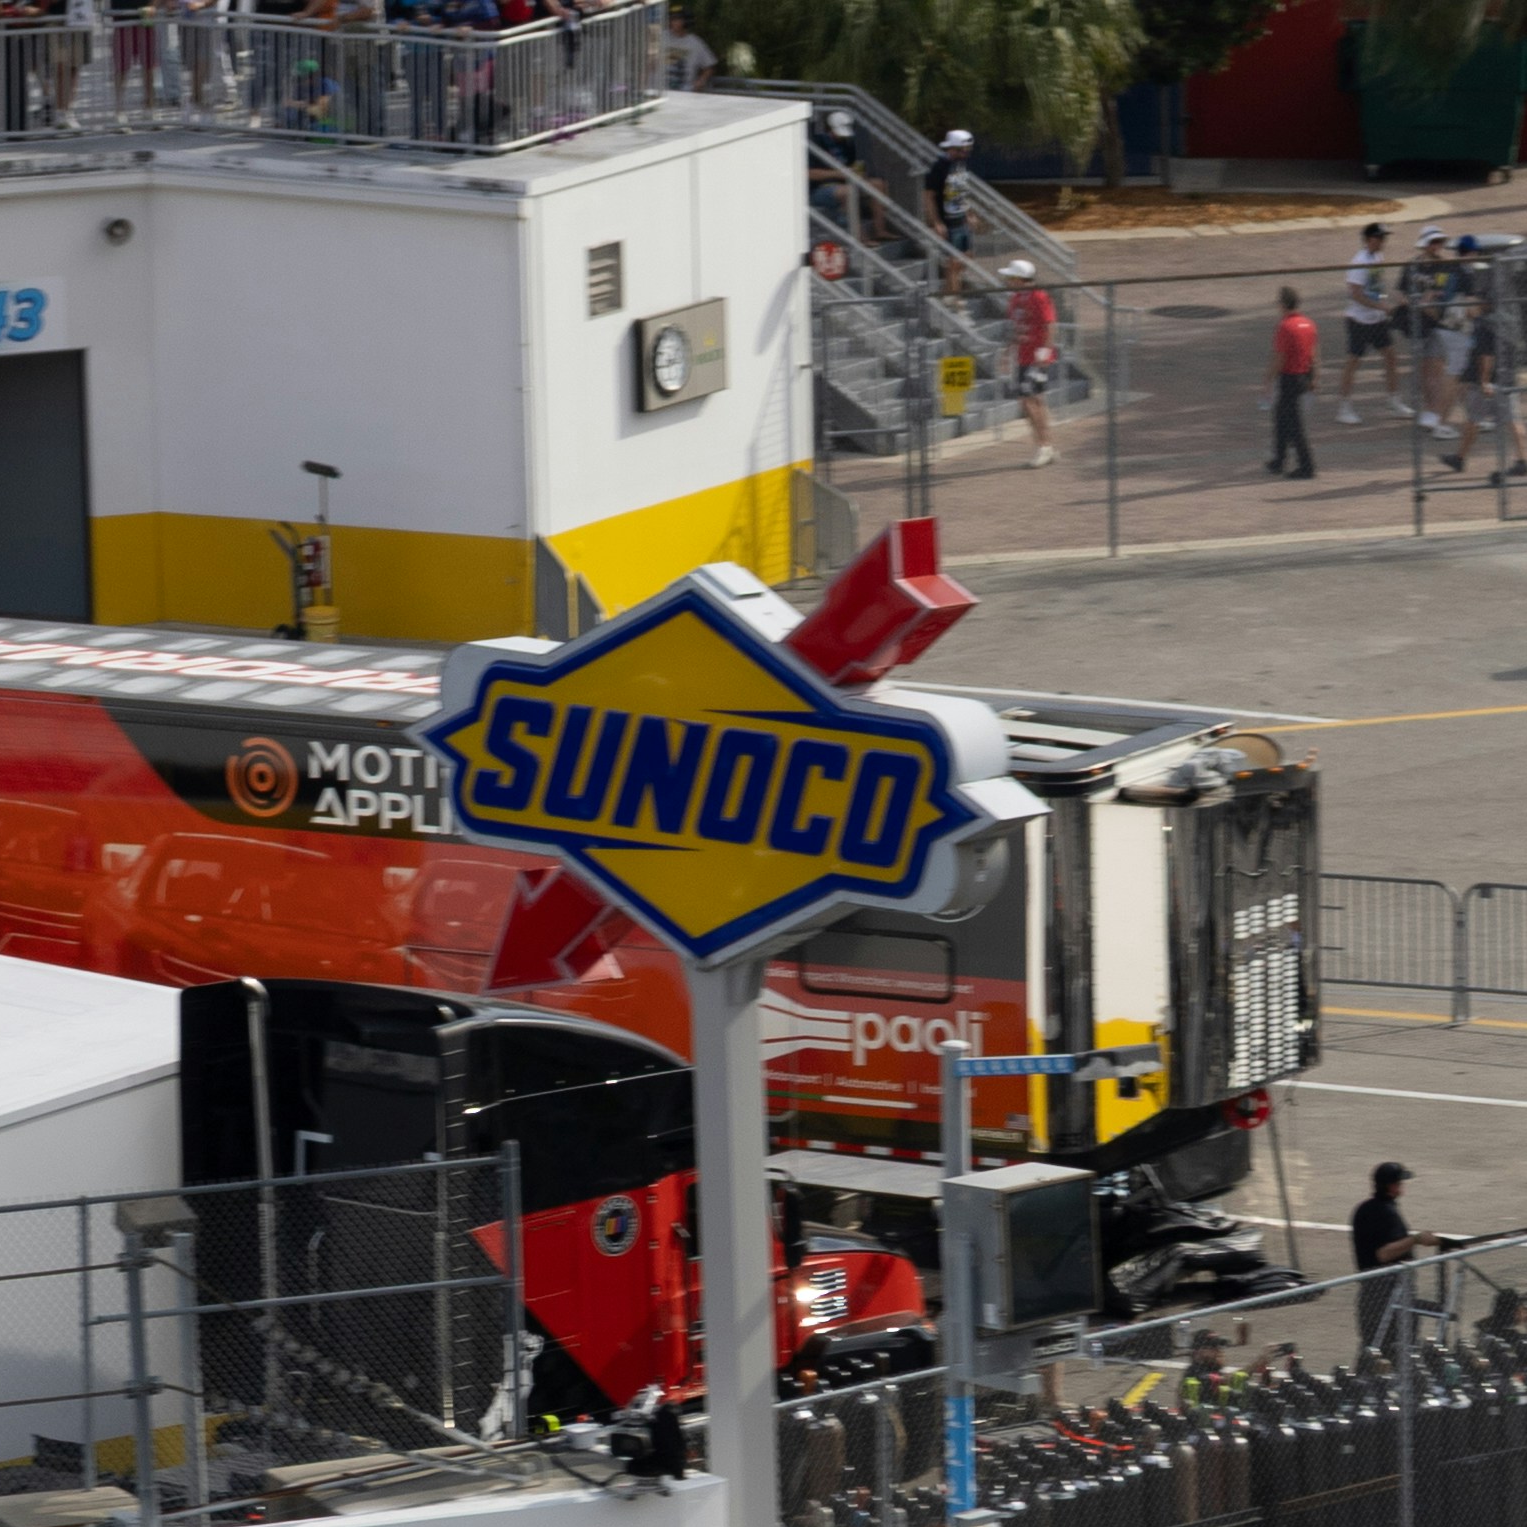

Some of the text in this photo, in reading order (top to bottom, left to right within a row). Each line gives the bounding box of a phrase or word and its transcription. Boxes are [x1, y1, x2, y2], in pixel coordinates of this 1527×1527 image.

[308, 741, 450, 789] MOTI
[472, 694, 922, 868] SUNOCO
[310, 788, 458, 836] APPLI
